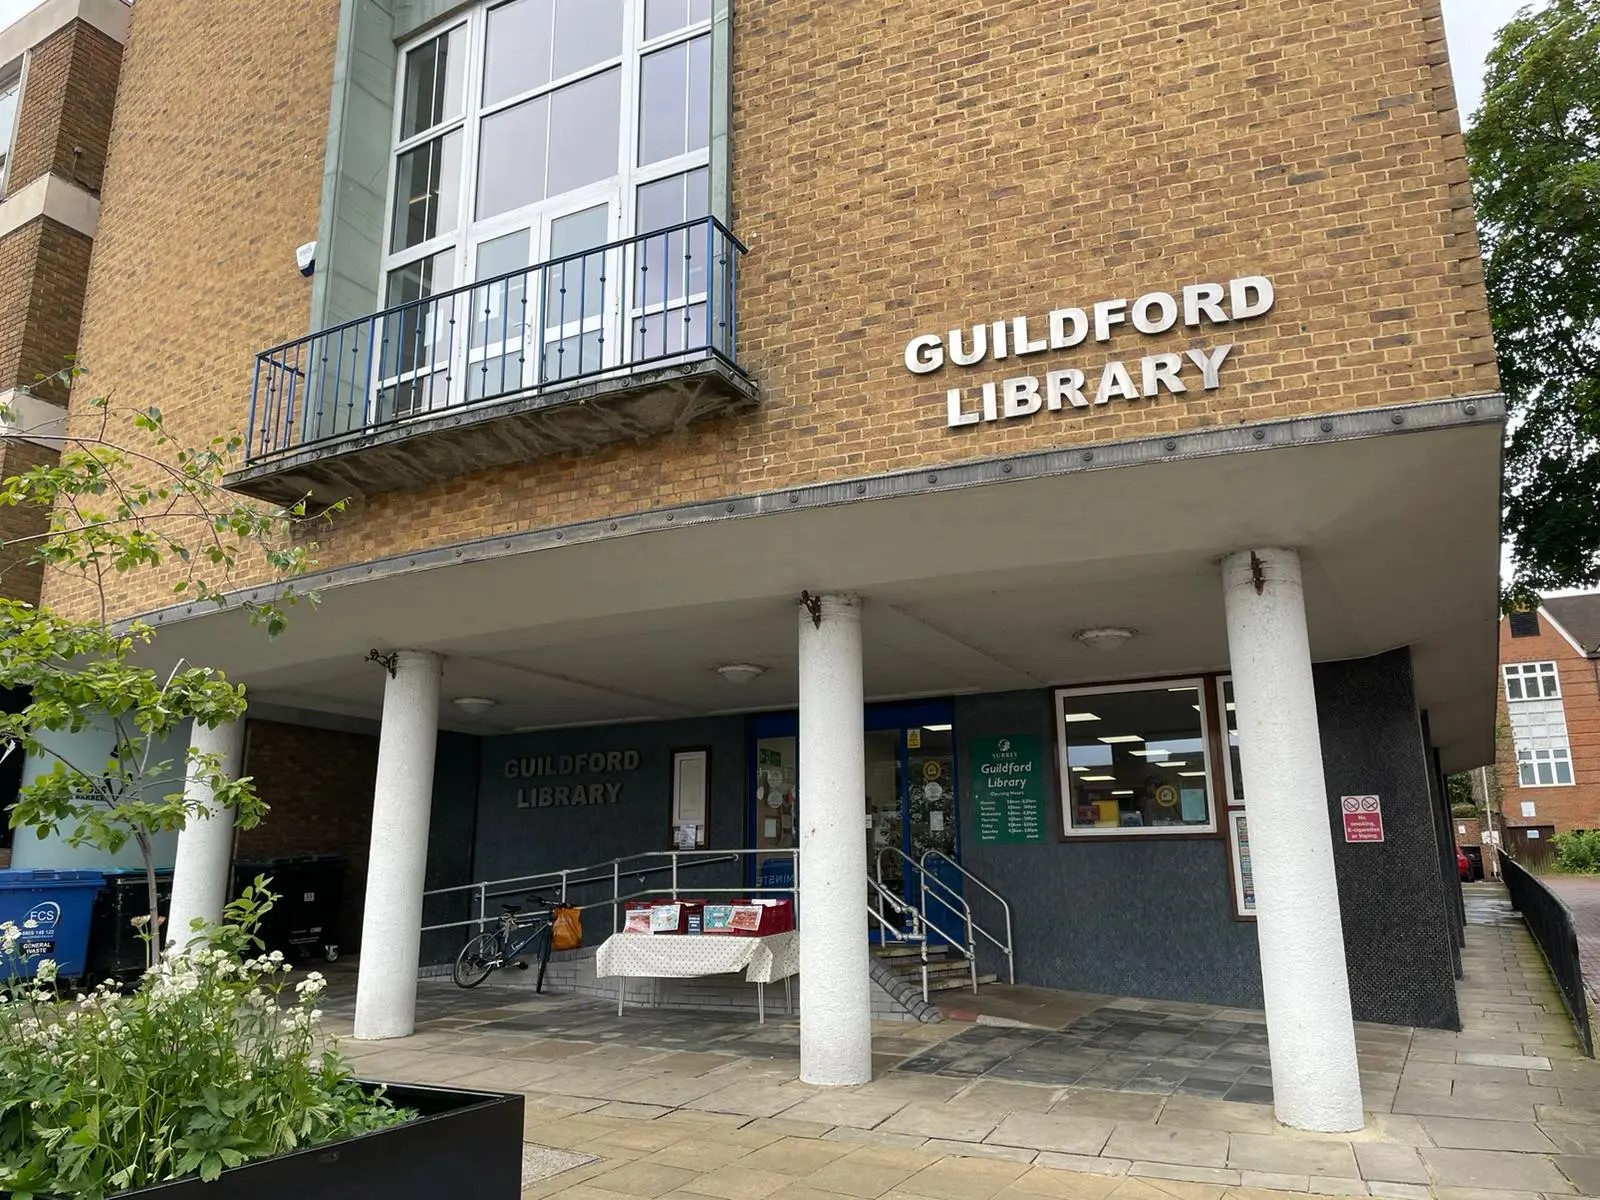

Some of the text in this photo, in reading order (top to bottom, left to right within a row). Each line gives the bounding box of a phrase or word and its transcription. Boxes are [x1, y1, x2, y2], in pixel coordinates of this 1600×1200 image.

[903, 275, 1275, 375] GUILDFORD
[946, 344, 1234, 428] LIBRARY
[503, 750, 641, 779] GUILDFORD
[981, 761, 1032, 775] Guildford
[516, 782, 623, 809] LIBRARY
[987, 777, 1027, 790] Library
